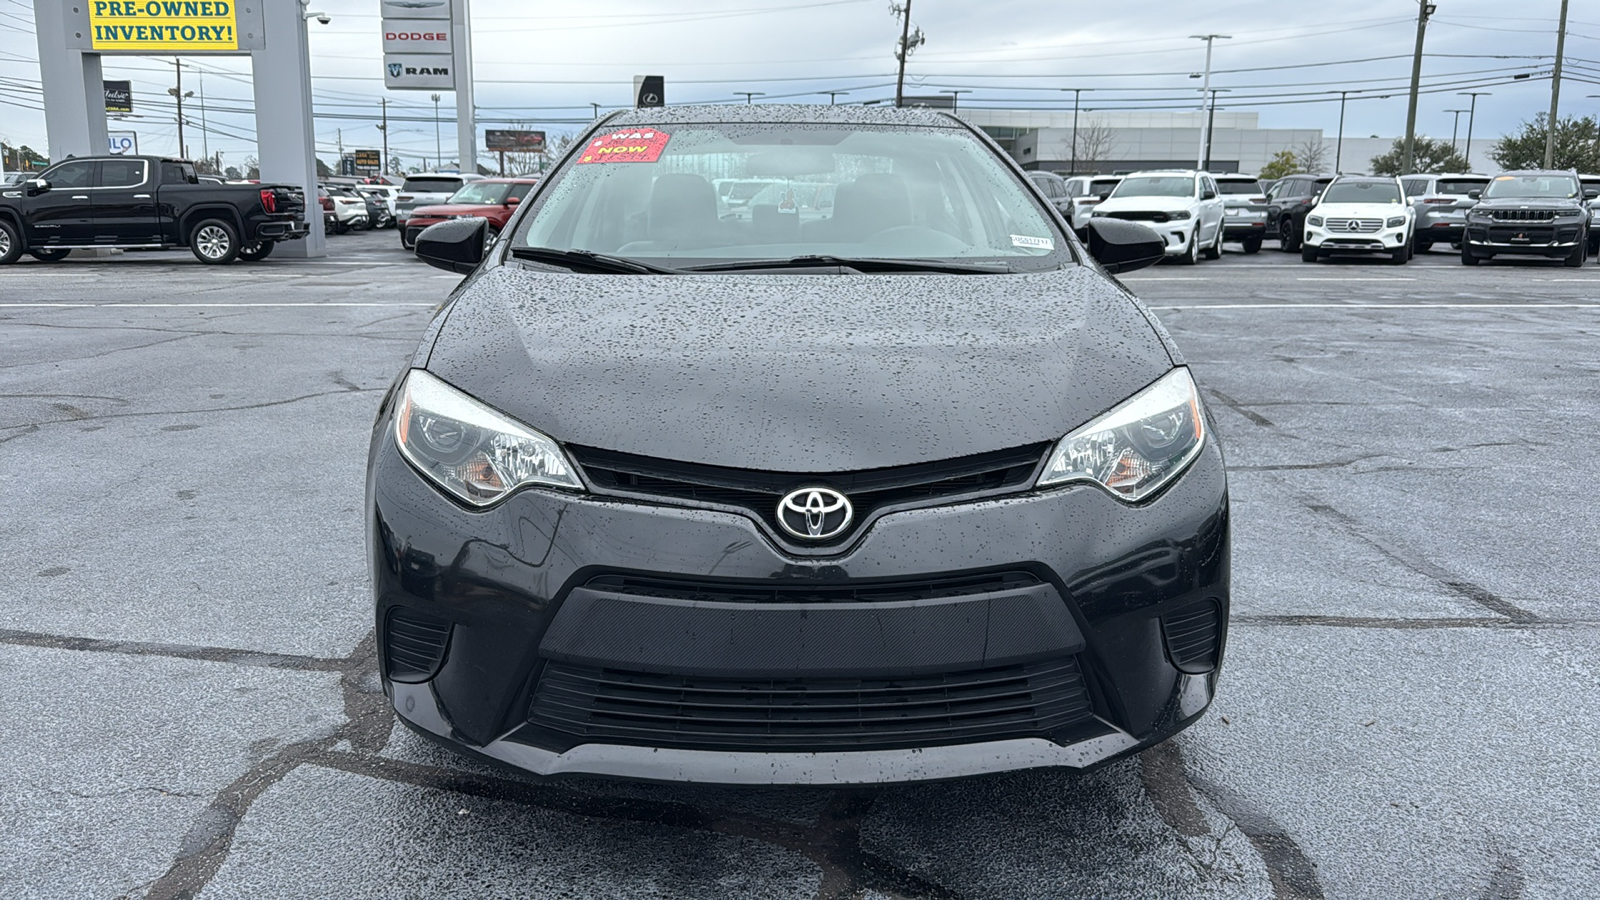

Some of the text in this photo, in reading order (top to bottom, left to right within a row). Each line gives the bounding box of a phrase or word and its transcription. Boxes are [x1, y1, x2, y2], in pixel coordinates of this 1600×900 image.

[94, 1, 230, 16] PRE-OWNED
[95, 25, 233, 41] INVENTORY!
[386, 33, 447, 41] DODGE
[405, 67, 449, 76] RAM
[598, 146, 648, 154] NOW
